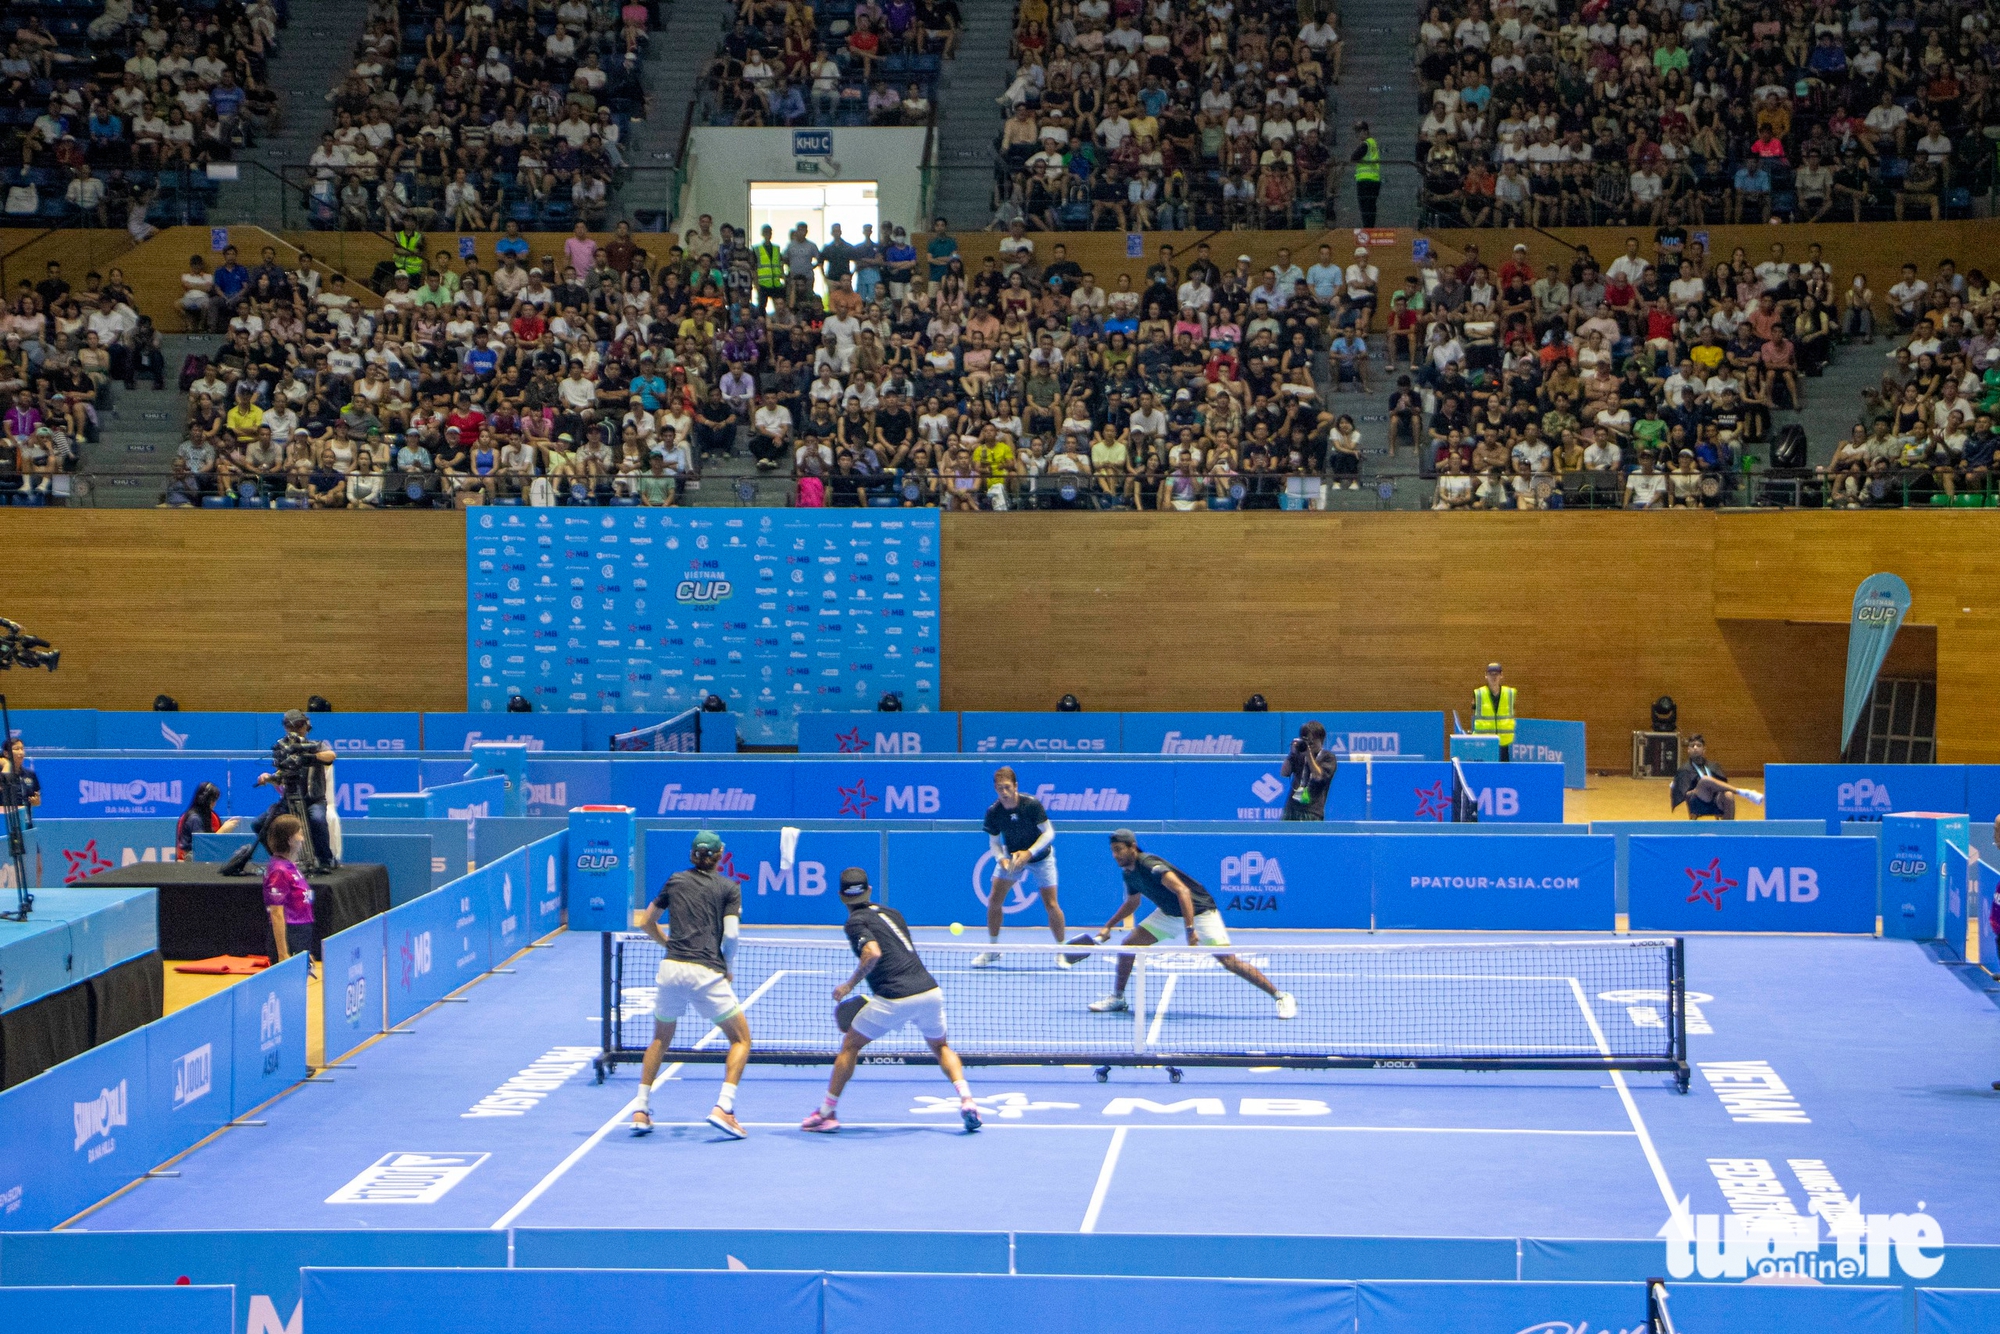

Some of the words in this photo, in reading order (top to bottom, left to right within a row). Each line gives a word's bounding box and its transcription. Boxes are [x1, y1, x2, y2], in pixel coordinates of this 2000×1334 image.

[796, 136, 819, 149] KHU
[821, 136, 829, 149] C
[702, 560, 718, 568] MB
[684, 571, 725, 580] VIETNAM
[676, 581, 731, 600] CUP
[1858, 606, 1897, 621] CUP
[654, 732, 696, 752] MB
[874, 732, 921, 753] MB
[1001, 738, 1105, 750] FACOLOS
[1162, 732, 1244, 753] Franklin
[1352, 734, 1396, 753] JOOLA
[1512, 744, 1534, 759] FPT
[1538, 746, 1563, 762] Play
[658, 784, 756, 814] Franklin
[886, 785, 940, 814] MB
[1035, 784, 1130, 811] Franklin
[1838, 778, 1891, 806] PPA
[1238, 808, 1261, 819] VIET
[577, 855, 618, 869] CUP
[1221, 851, 1285, 884] PPA
[1889, 860, 1927, 875] CUP
[758, 861, 827, 895] MB
[1411, 876, 1580, 889] PPATOUR-ASIA.COM
[1746, 866, 1820, 902] MB
[1227, 896, 1278, 911] ASIA
[414, 931, 431, 978] MB
[186, 1050, 209, 1096] JOOLA
[262, 1049, 279, 1080] ASIA
[1696, 1060, 1812, 1123] VIETNAM
[1101, 1097, 1332, 1116] MB
[347, 1169, 449, 1200] JOOLA
